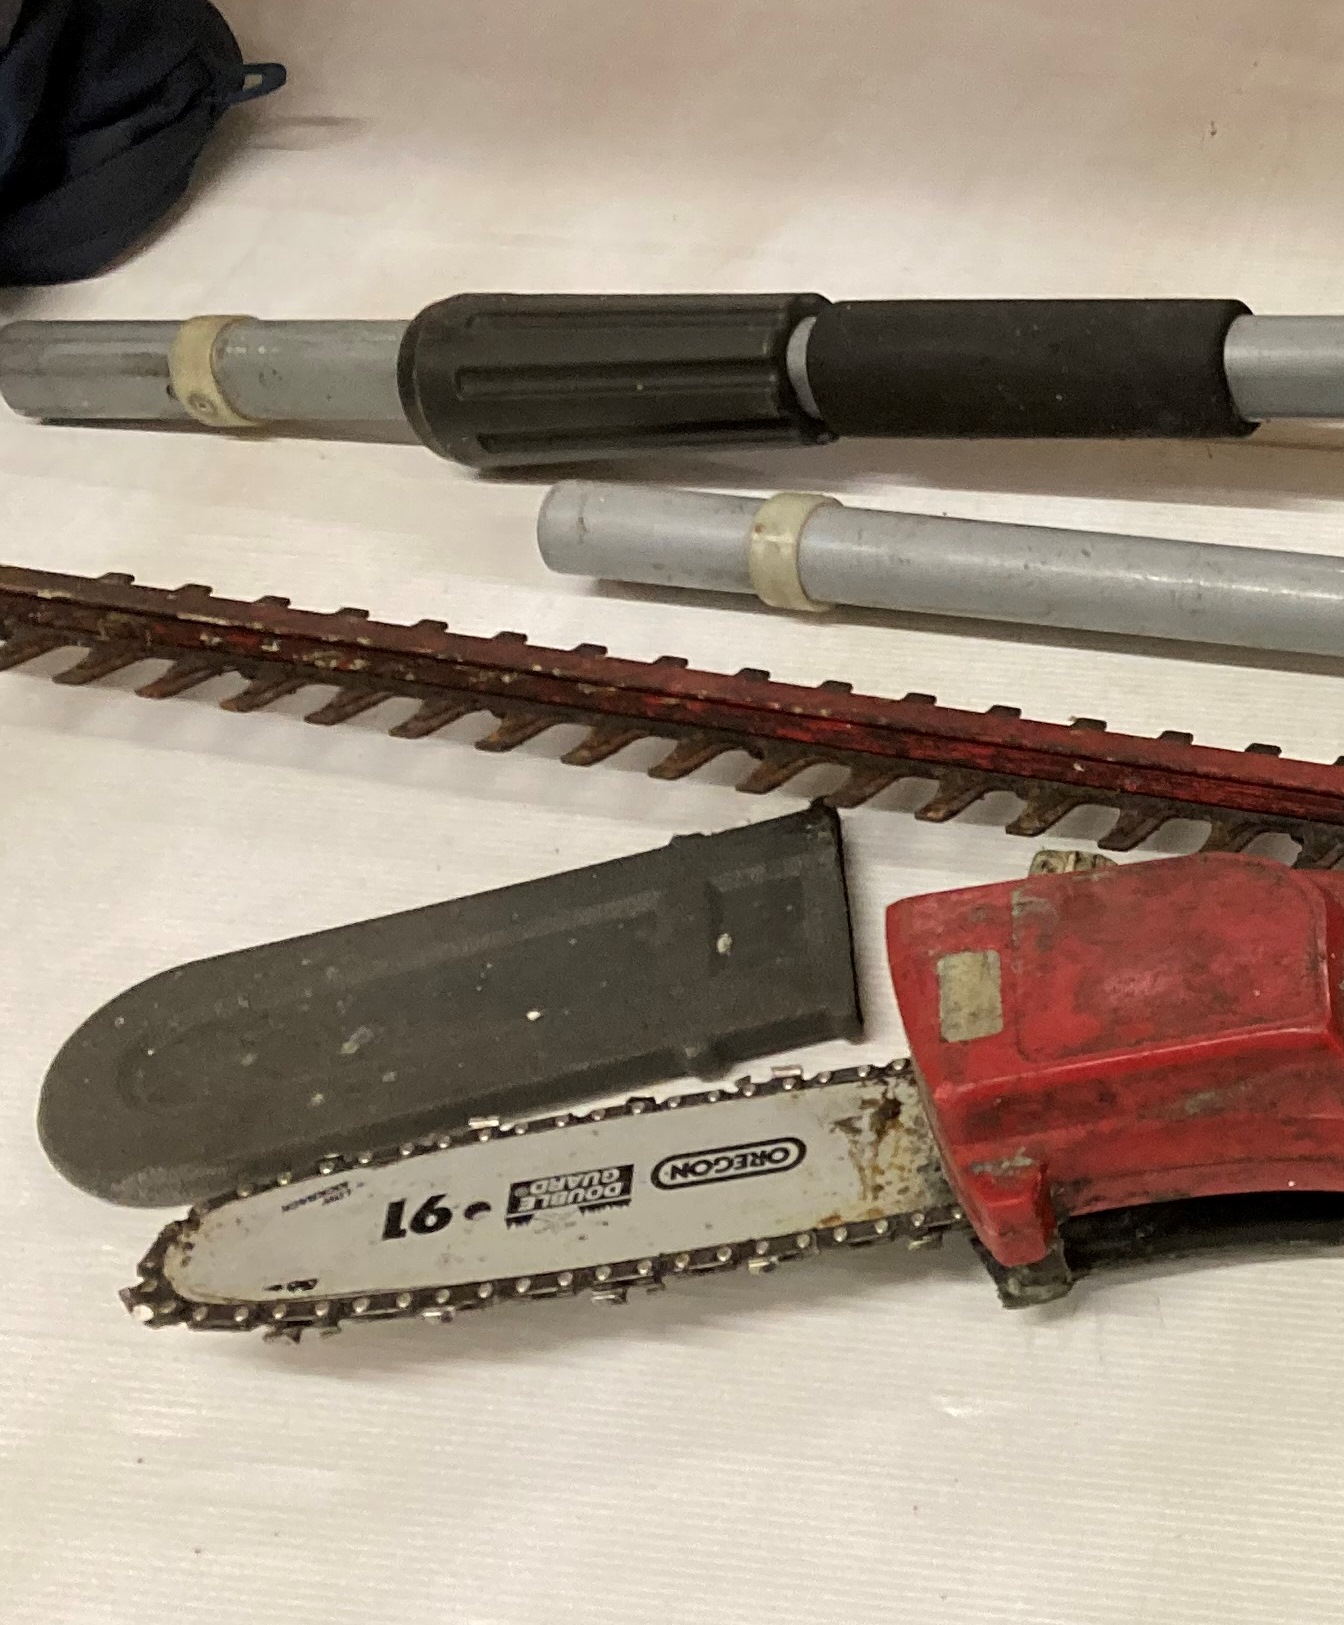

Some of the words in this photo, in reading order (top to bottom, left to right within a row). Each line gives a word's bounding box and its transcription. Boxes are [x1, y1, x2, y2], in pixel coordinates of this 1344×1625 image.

[670, 1147, 790, 1181] OREGON
[517, 1182, 623, 1212] DOUBLE
[382, 1194, 453, 1241] 91
